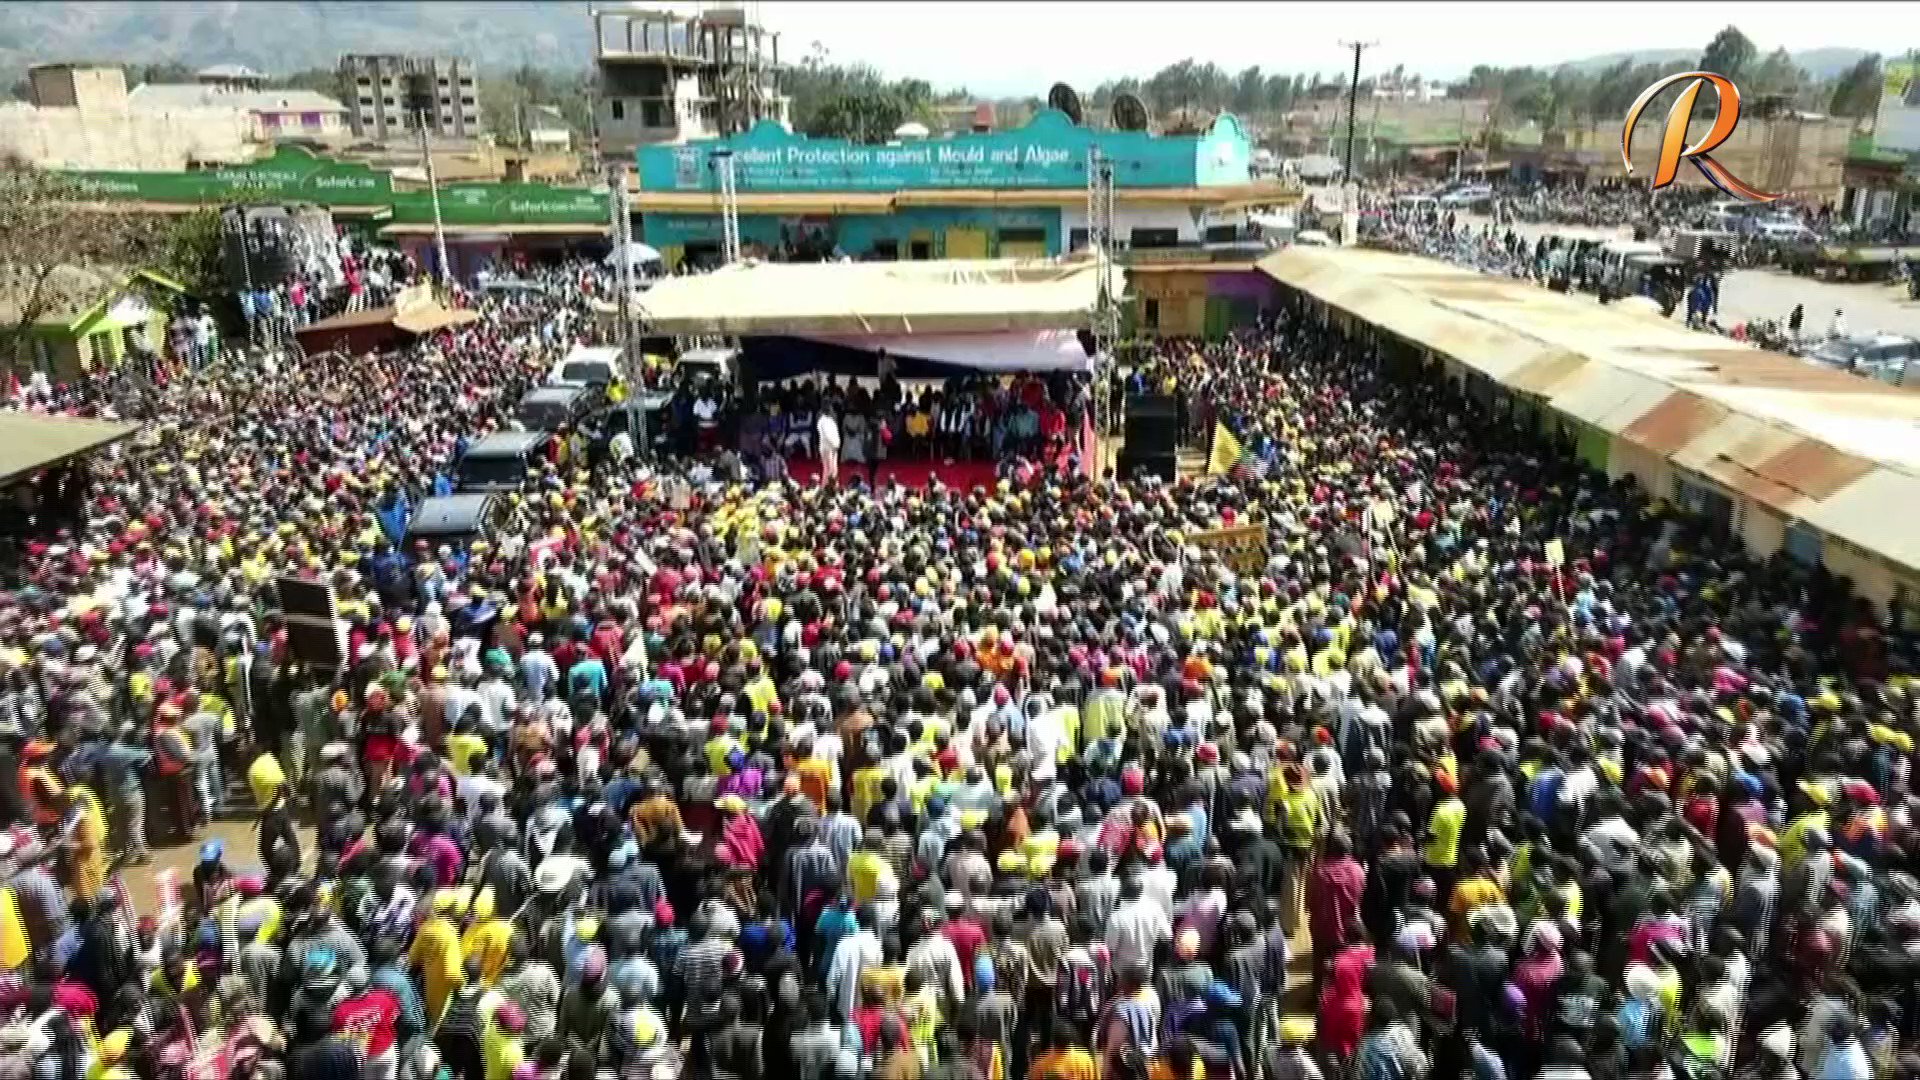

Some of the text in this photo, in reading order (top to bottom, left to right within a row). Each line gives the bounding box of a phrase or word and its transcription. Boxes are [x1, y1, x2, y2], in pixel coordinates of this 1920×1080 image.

[787, 146, 870, 164] Protection
[876, 147, 931, 168] against
[938, 146, 983, 164] Mould
[990, 146, 1018, 164] and
[1024, 146, 1070, 169] Algae
